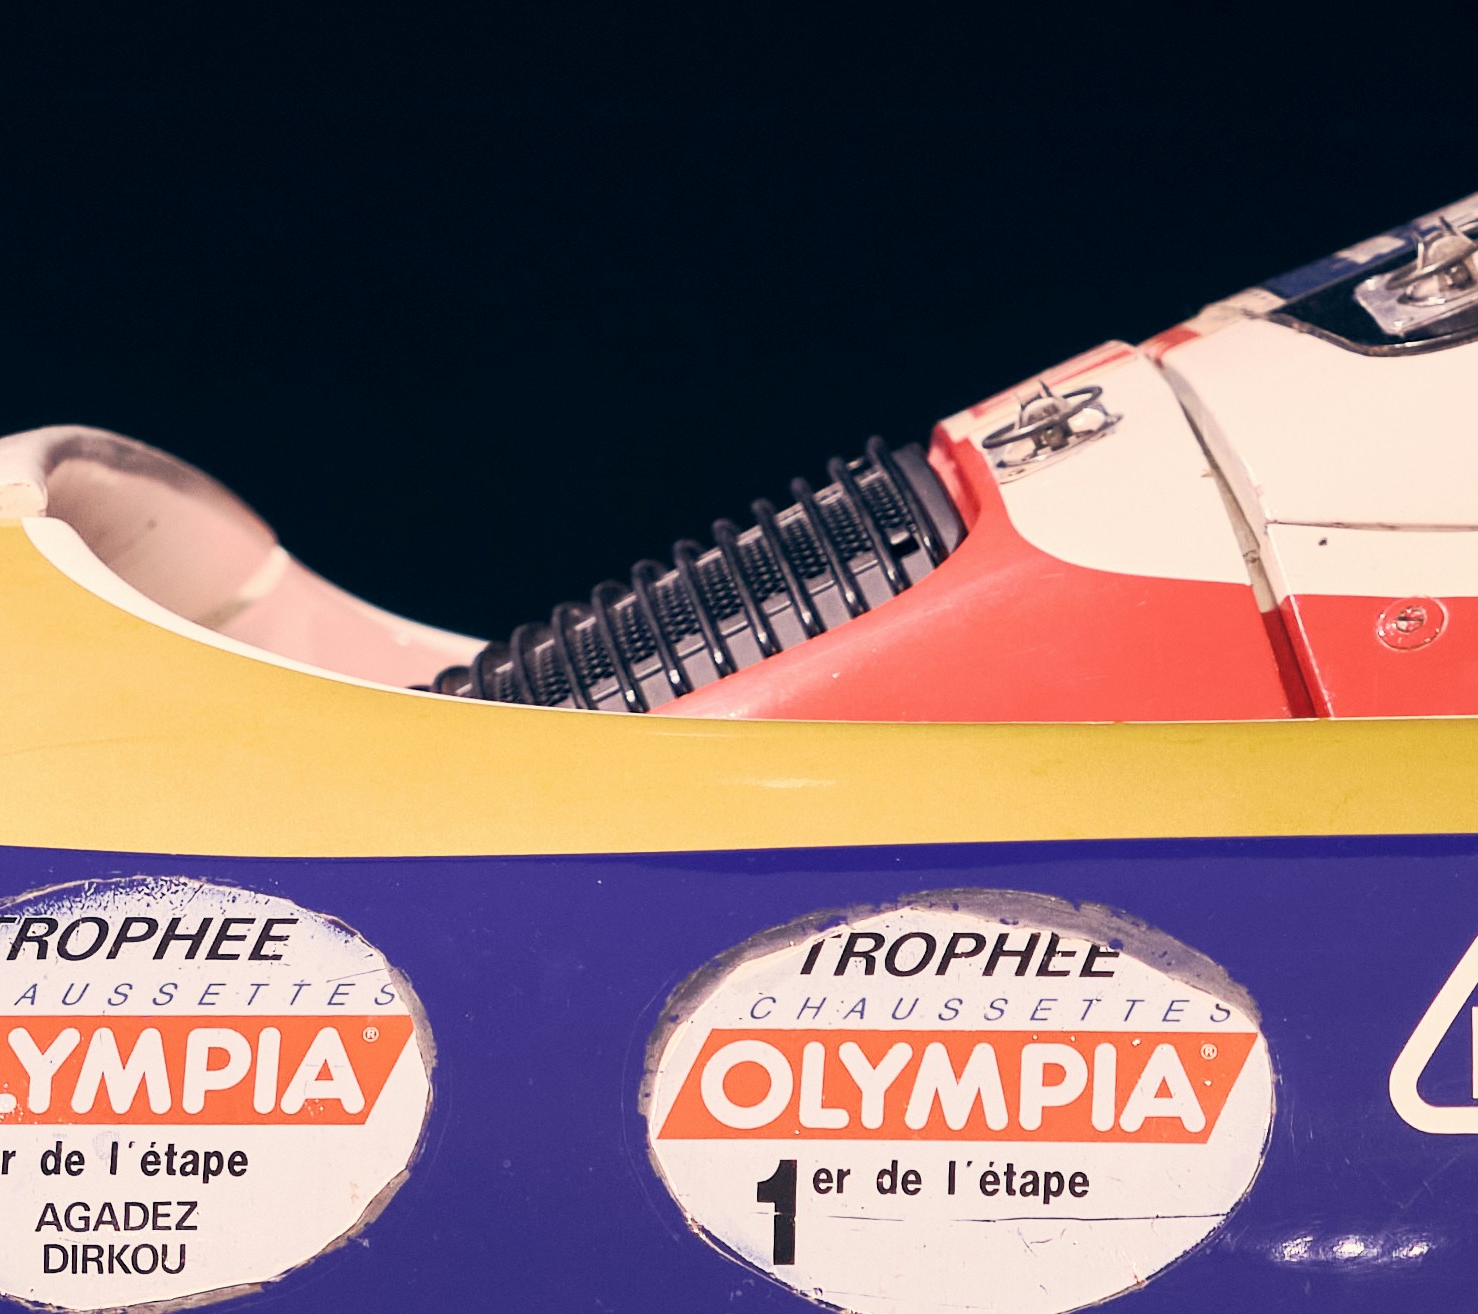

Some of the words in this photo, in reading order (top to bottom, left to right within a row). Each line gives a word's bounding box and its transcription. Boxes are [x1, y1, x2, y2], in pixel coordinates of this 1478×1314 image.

[750, 996, 1233, 1023] CHAUSSETTES
[41, 1140, 85, 1177] de
[875, 1160, 922, 1195] de
[34, 1201, 199, 1233] AGADEZ
[42, 1243, 186, 1275] DIRKOU
